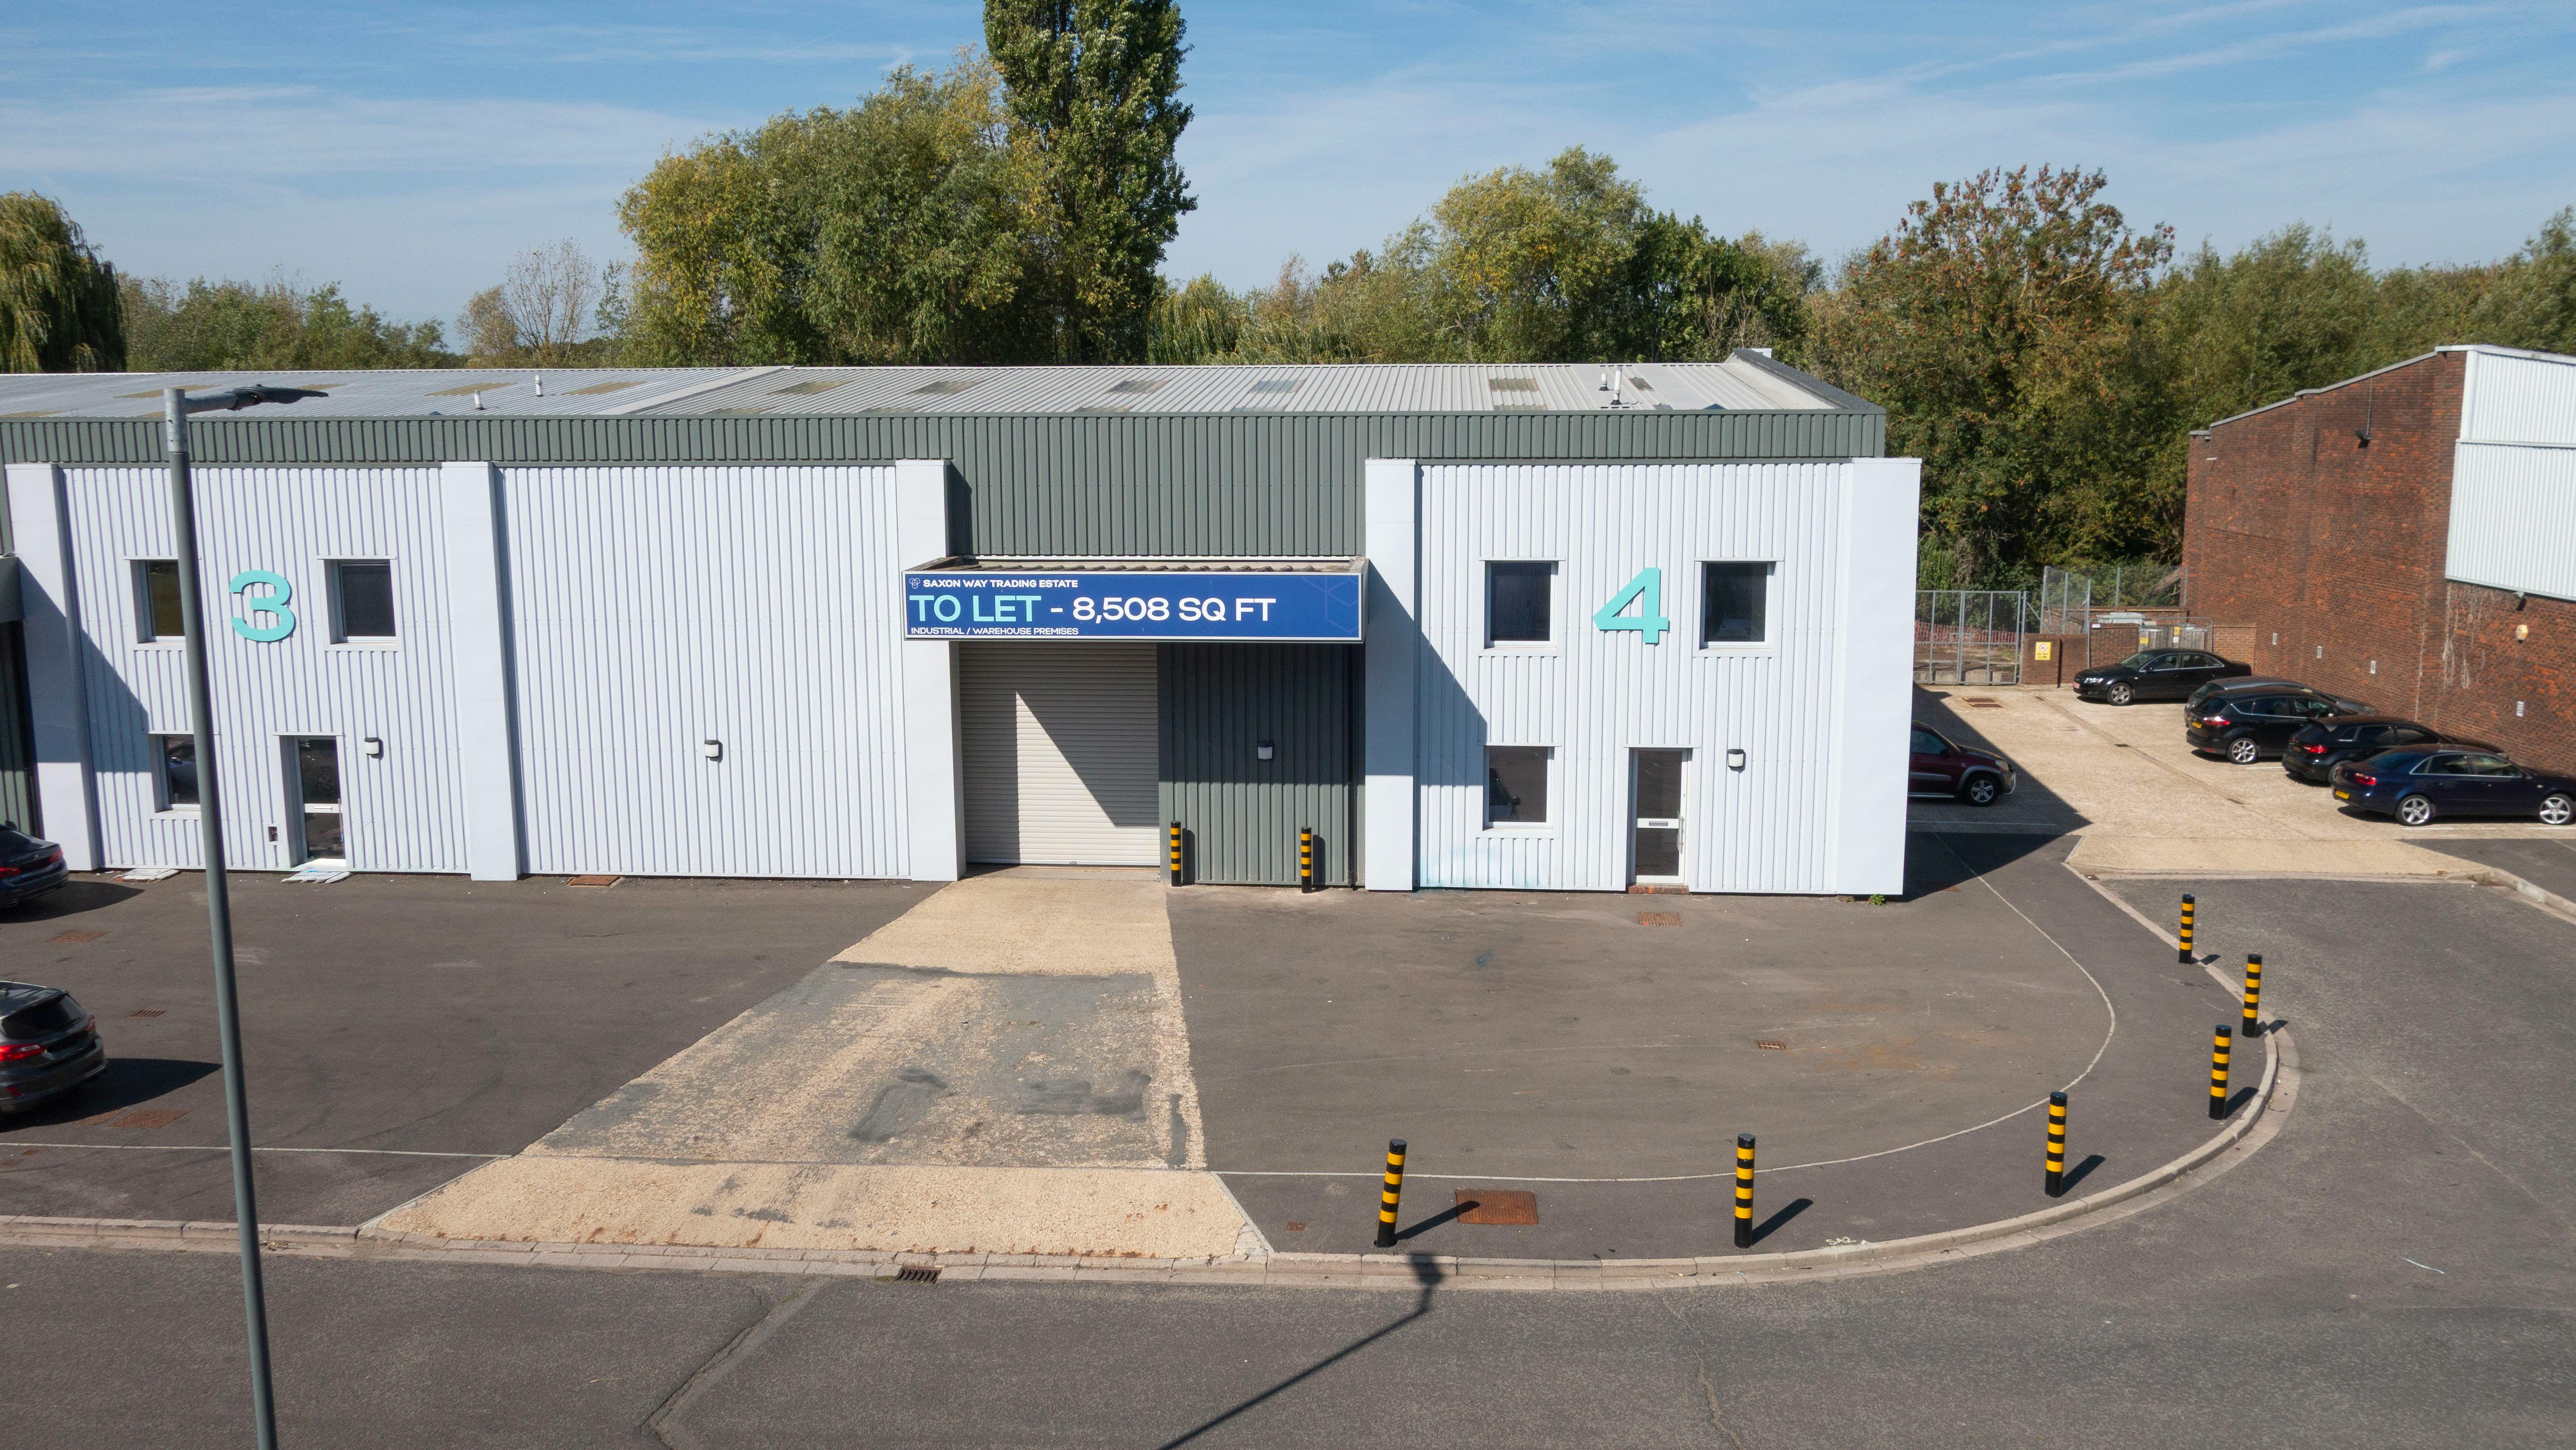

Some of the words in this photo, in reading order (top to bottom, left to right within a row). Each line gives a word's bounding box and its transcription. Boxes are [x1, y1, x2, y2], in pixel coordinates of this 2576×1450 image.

[229, 570, 296, 642] 3
[923, 579, 961, 588] SAXON
[962, 580, 988, 588] WAY
[990, 580, 1037, 588] TRADING
[1038, 580, 1078, 588] ESTATE
[1592, 567, 1669, 644] 4
[909, 595, 961, 622] TO
[973, 595, 1042, 622] LET
[1073, 596, 1170, 624] 8,508
[1179, 597, 1226, 621] SQ
[1236, 598, 1276, 621] FT
